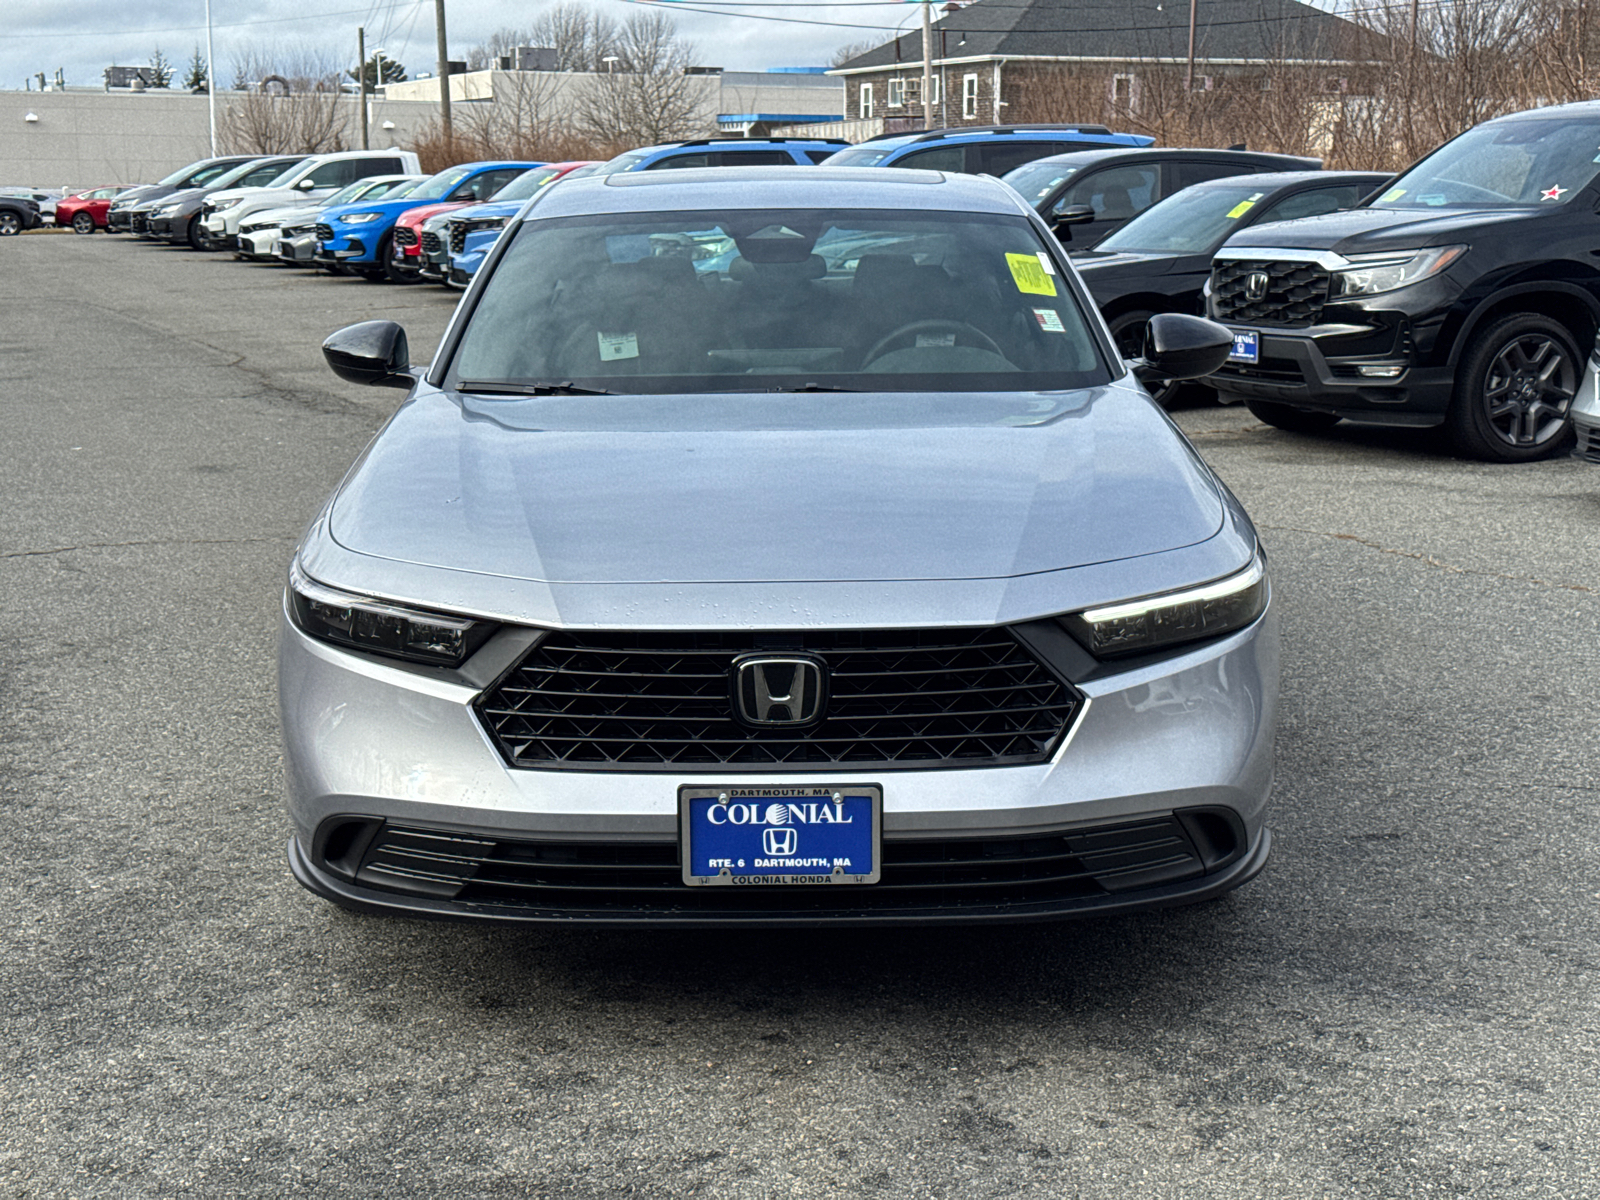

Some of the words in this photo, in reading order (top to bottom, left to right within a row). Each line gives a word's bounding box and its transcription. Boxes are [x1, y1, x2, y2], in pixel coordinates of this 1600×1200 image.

[731, 789, 808, 797] DARTMOUTH,
[812, 788, 831, 796] MA
[706, 803, 853, 826] COLONIAL
[708, 859, 735, 868] RTE.
[737, 859, 745, 868] 6
[754, 858, 831, 868] DARTMOUTH,
[833, 858, 852, 867] MA
[731, 876, 788, 885] COLONIAL
[791, 875, 832, 884] HONDA
